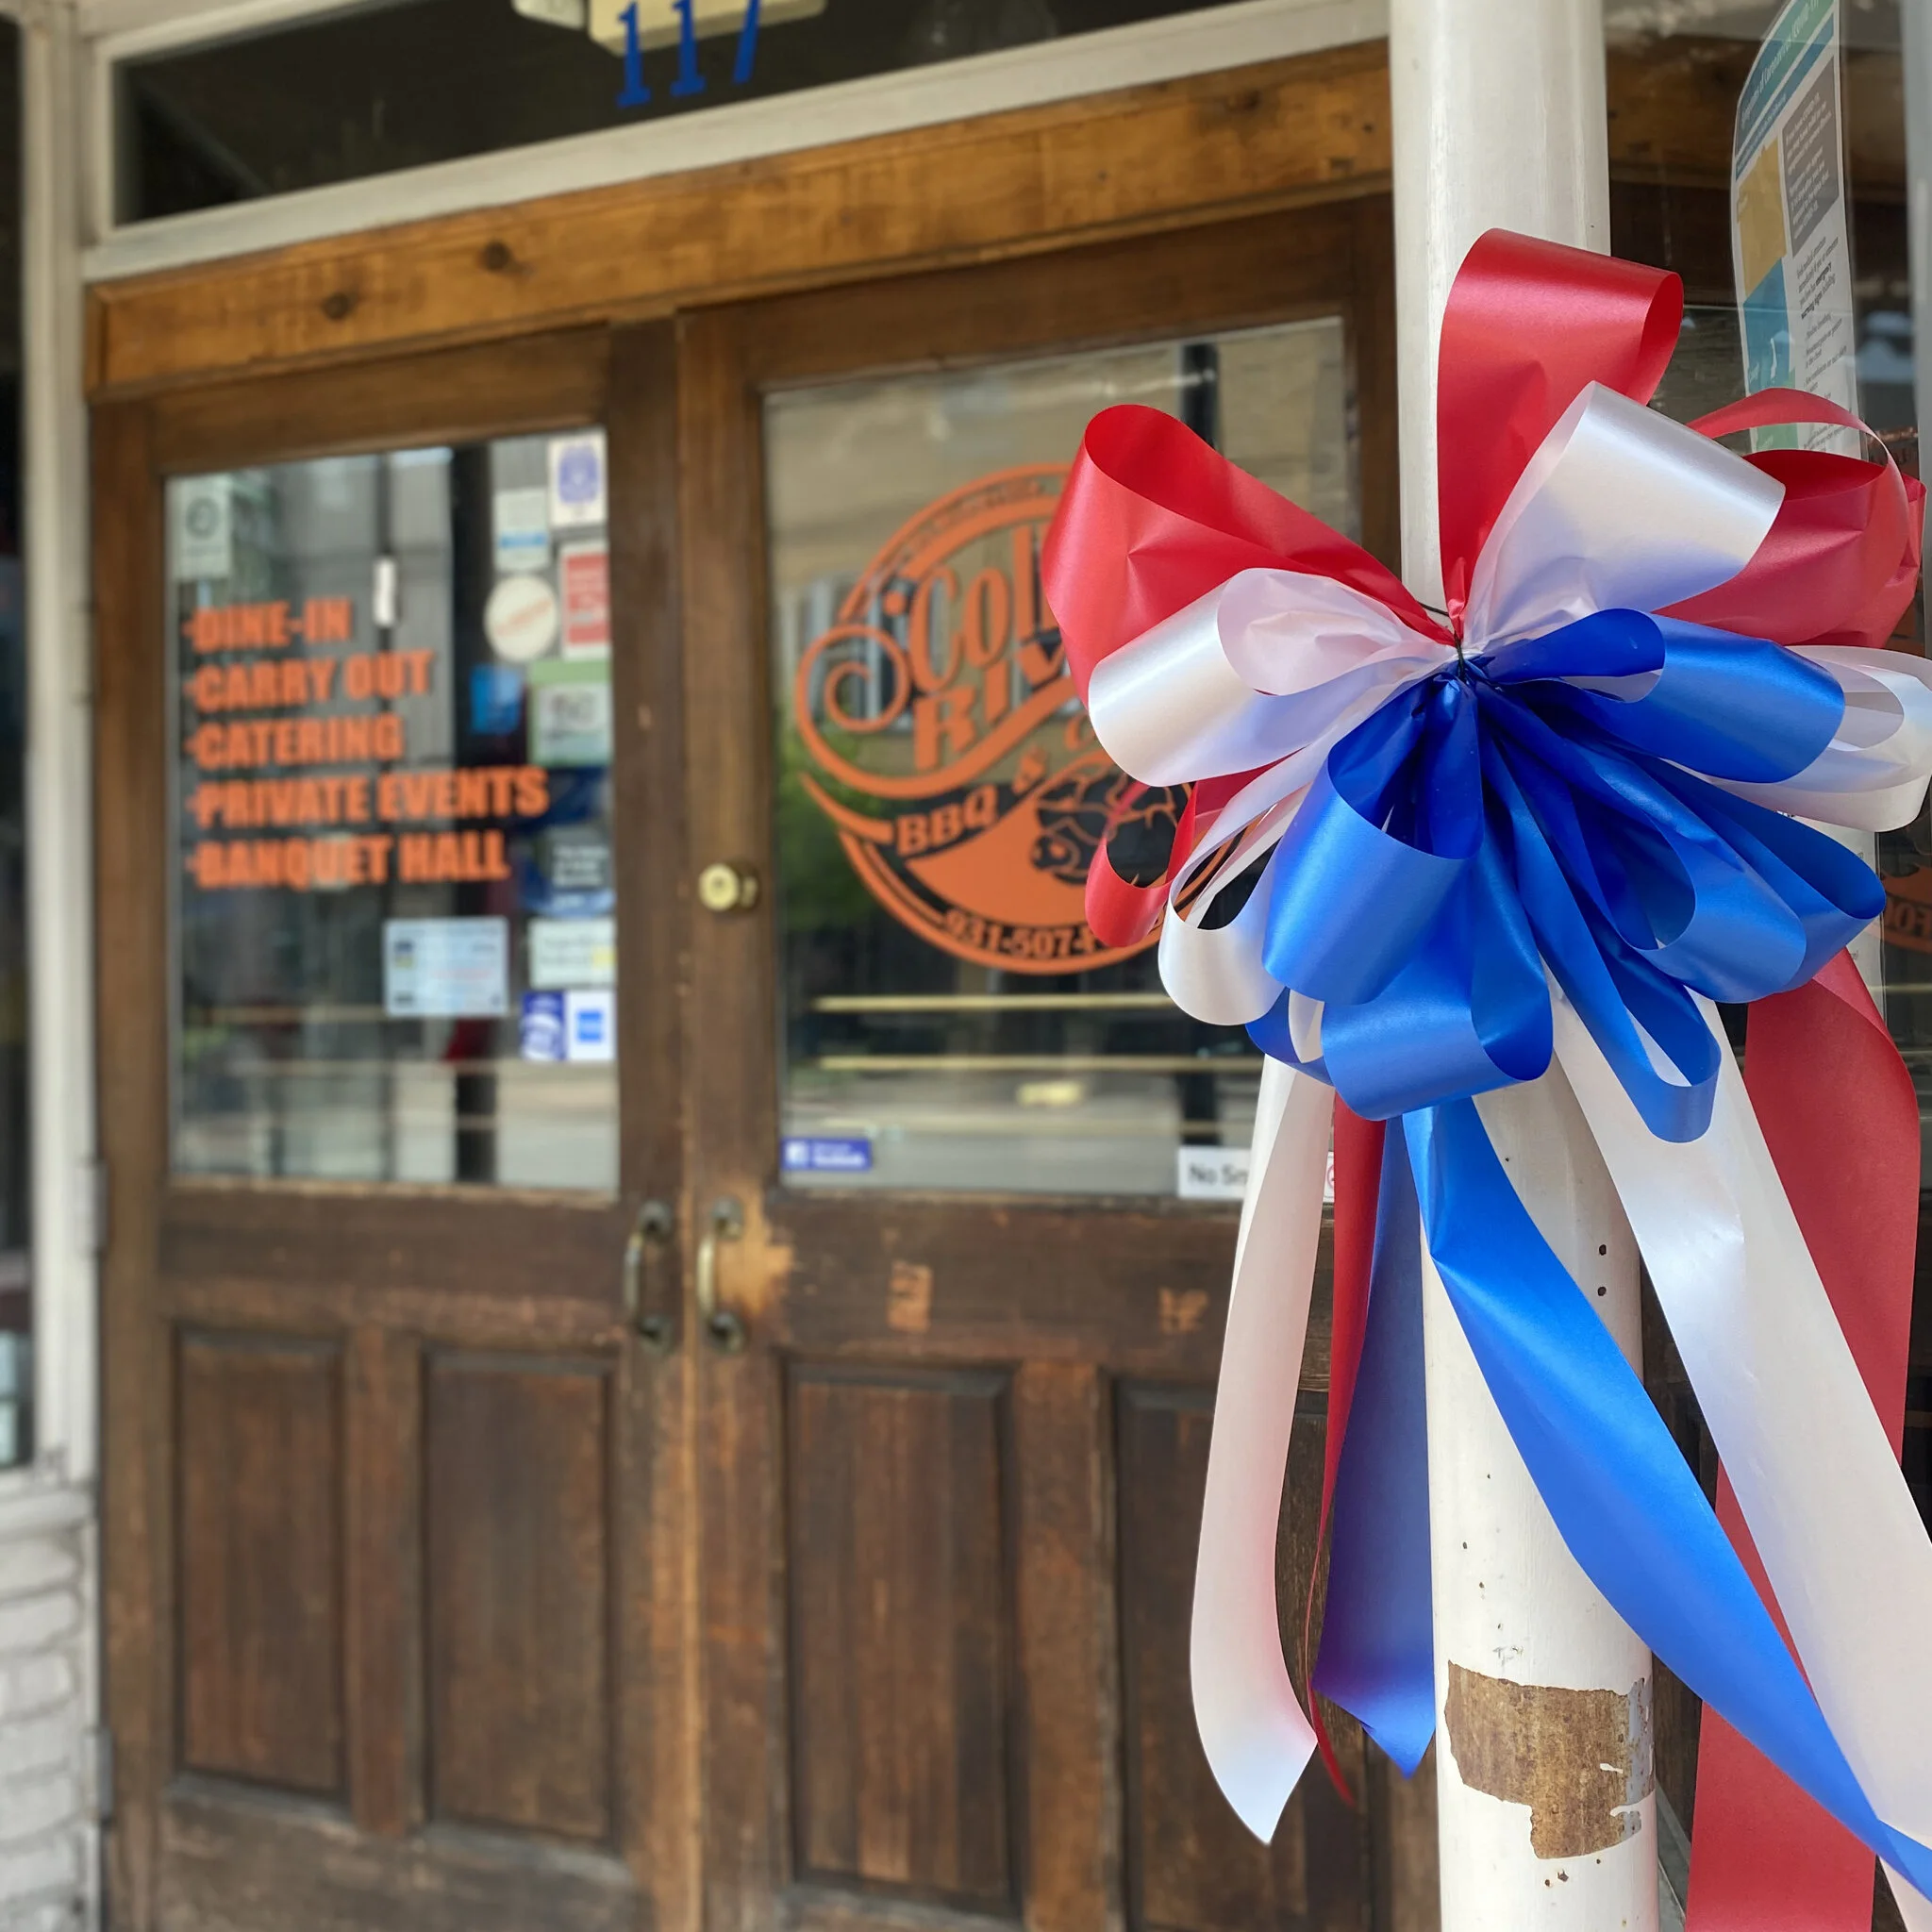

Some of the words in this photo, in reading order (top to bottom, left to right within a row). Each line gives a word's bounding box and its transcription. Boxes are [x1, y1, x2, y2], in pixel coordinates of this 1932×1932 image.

[193, 598, 352, 653] DINE-IN
[193, 658, 336, 712] CARRY
[343, 651, 434, 700] OUT
[193, 713, 404, 770] CATERING
[193, 775, 370, 828] PRIVATE
[379, 765, 549, 822] EVENTS
[897, 784, 997, 858] BBQ
[193, 833, 393, 891] BANQUET
[398, 829, 509, 882] HALL
